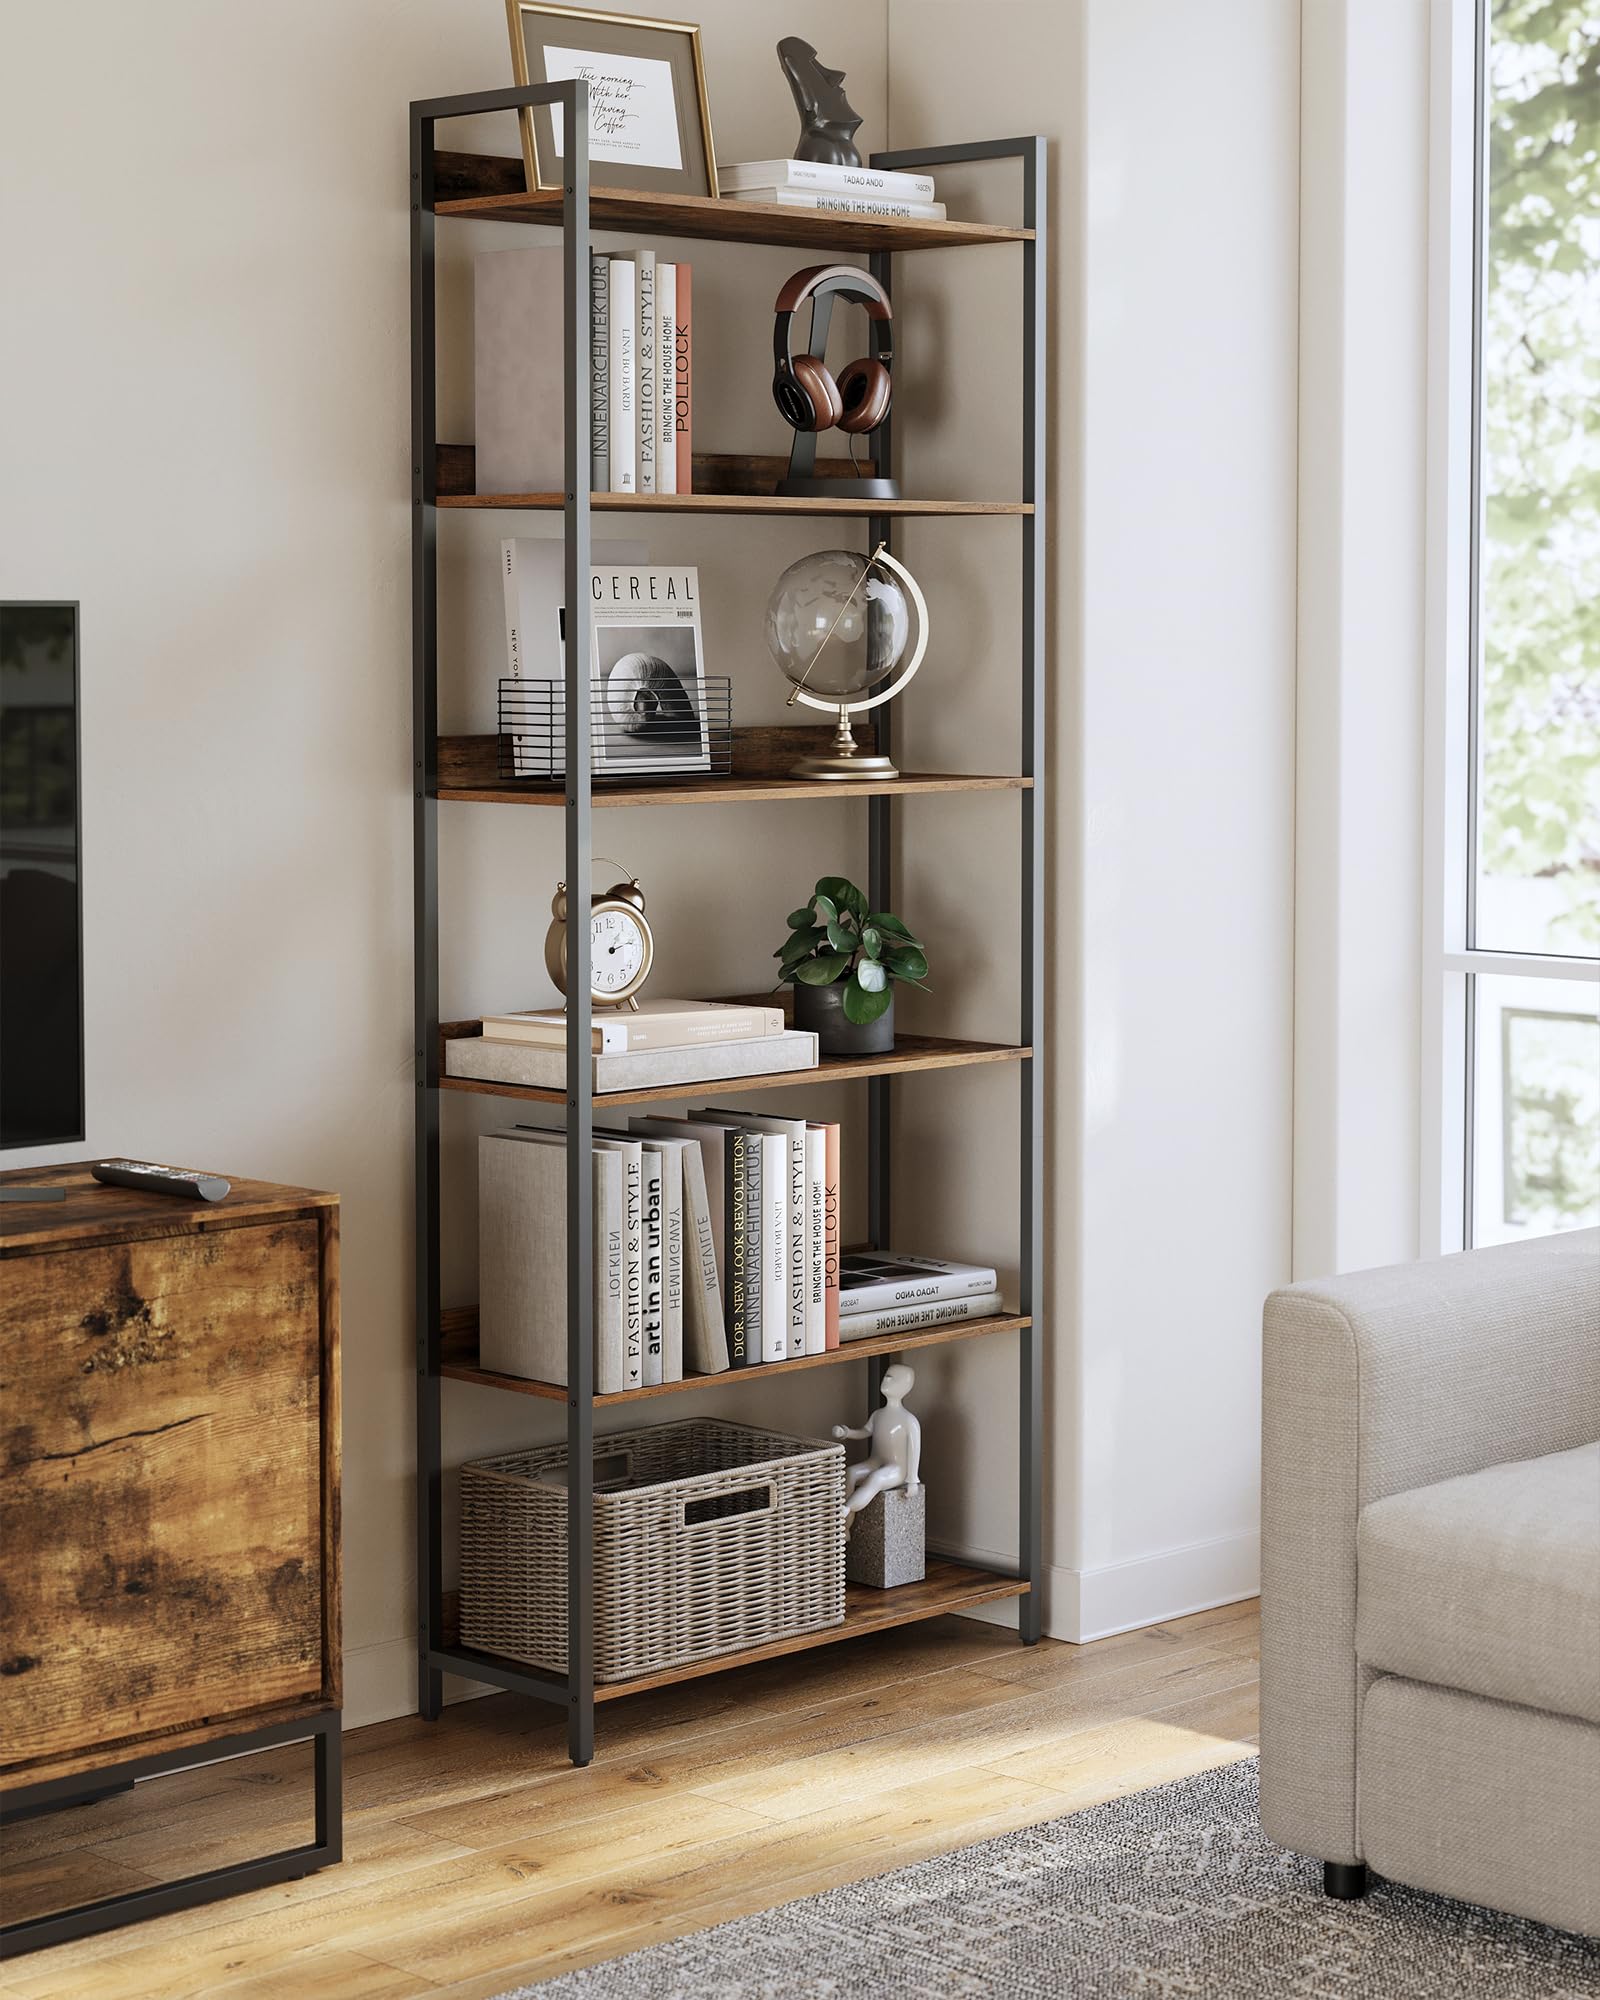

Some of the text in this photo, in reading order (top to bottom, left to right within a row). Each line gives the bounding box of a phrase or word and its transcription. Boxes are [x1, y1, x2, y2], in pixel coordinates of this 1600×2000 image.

[574, 67, 597, 80] This
[588, 81, 612, 100] With
[592, 98, 640, 121] Having
[594, 113, 625, 134] Coffee
[816, 197, 911, 217] BRINGING THE HOUSE HOME
[843, 174, 884, 188] TADAO ANDO
[592, 265, 607, 458] INNENARCHITEKTUR
[622, 328, 631, 412] LINA BO BARDI
[641, 270, 653, 462] FASHION & STYLE
[663, 316, 672, 443] BRINGING THE HOUSE HOME
[676, 324, 689, 432] POLLOCK
[591, 576, 694, 600] CEREAL
[595, 922, 602, 933] 11
[606, 918, 616, 929] 12
[596, 971, 602, 982] 7
[607, 973, 615, 984] 6
[620, 969, 627, 980] 5
[626, 960, 632, 969] 4
[734, 1135, 744, 1357] DIOR. NEW LOOK REVOLUTION
[746, 1143, 761, 1329] INNENARCHITEKTUR
[775, 1201, 783, 1281] LINA BO BARDI
[792, 1139, 804, 1326] FASHION & STYLE
[813, 1180, 821, 1304] BRINGING THE HOUSE HOME
[825, 1183, 837, 1289] POLLOCK
[628, 1162, 641, 1359] FASHION & STYLE
[642, 1178, 661, 1354] art in an urban
